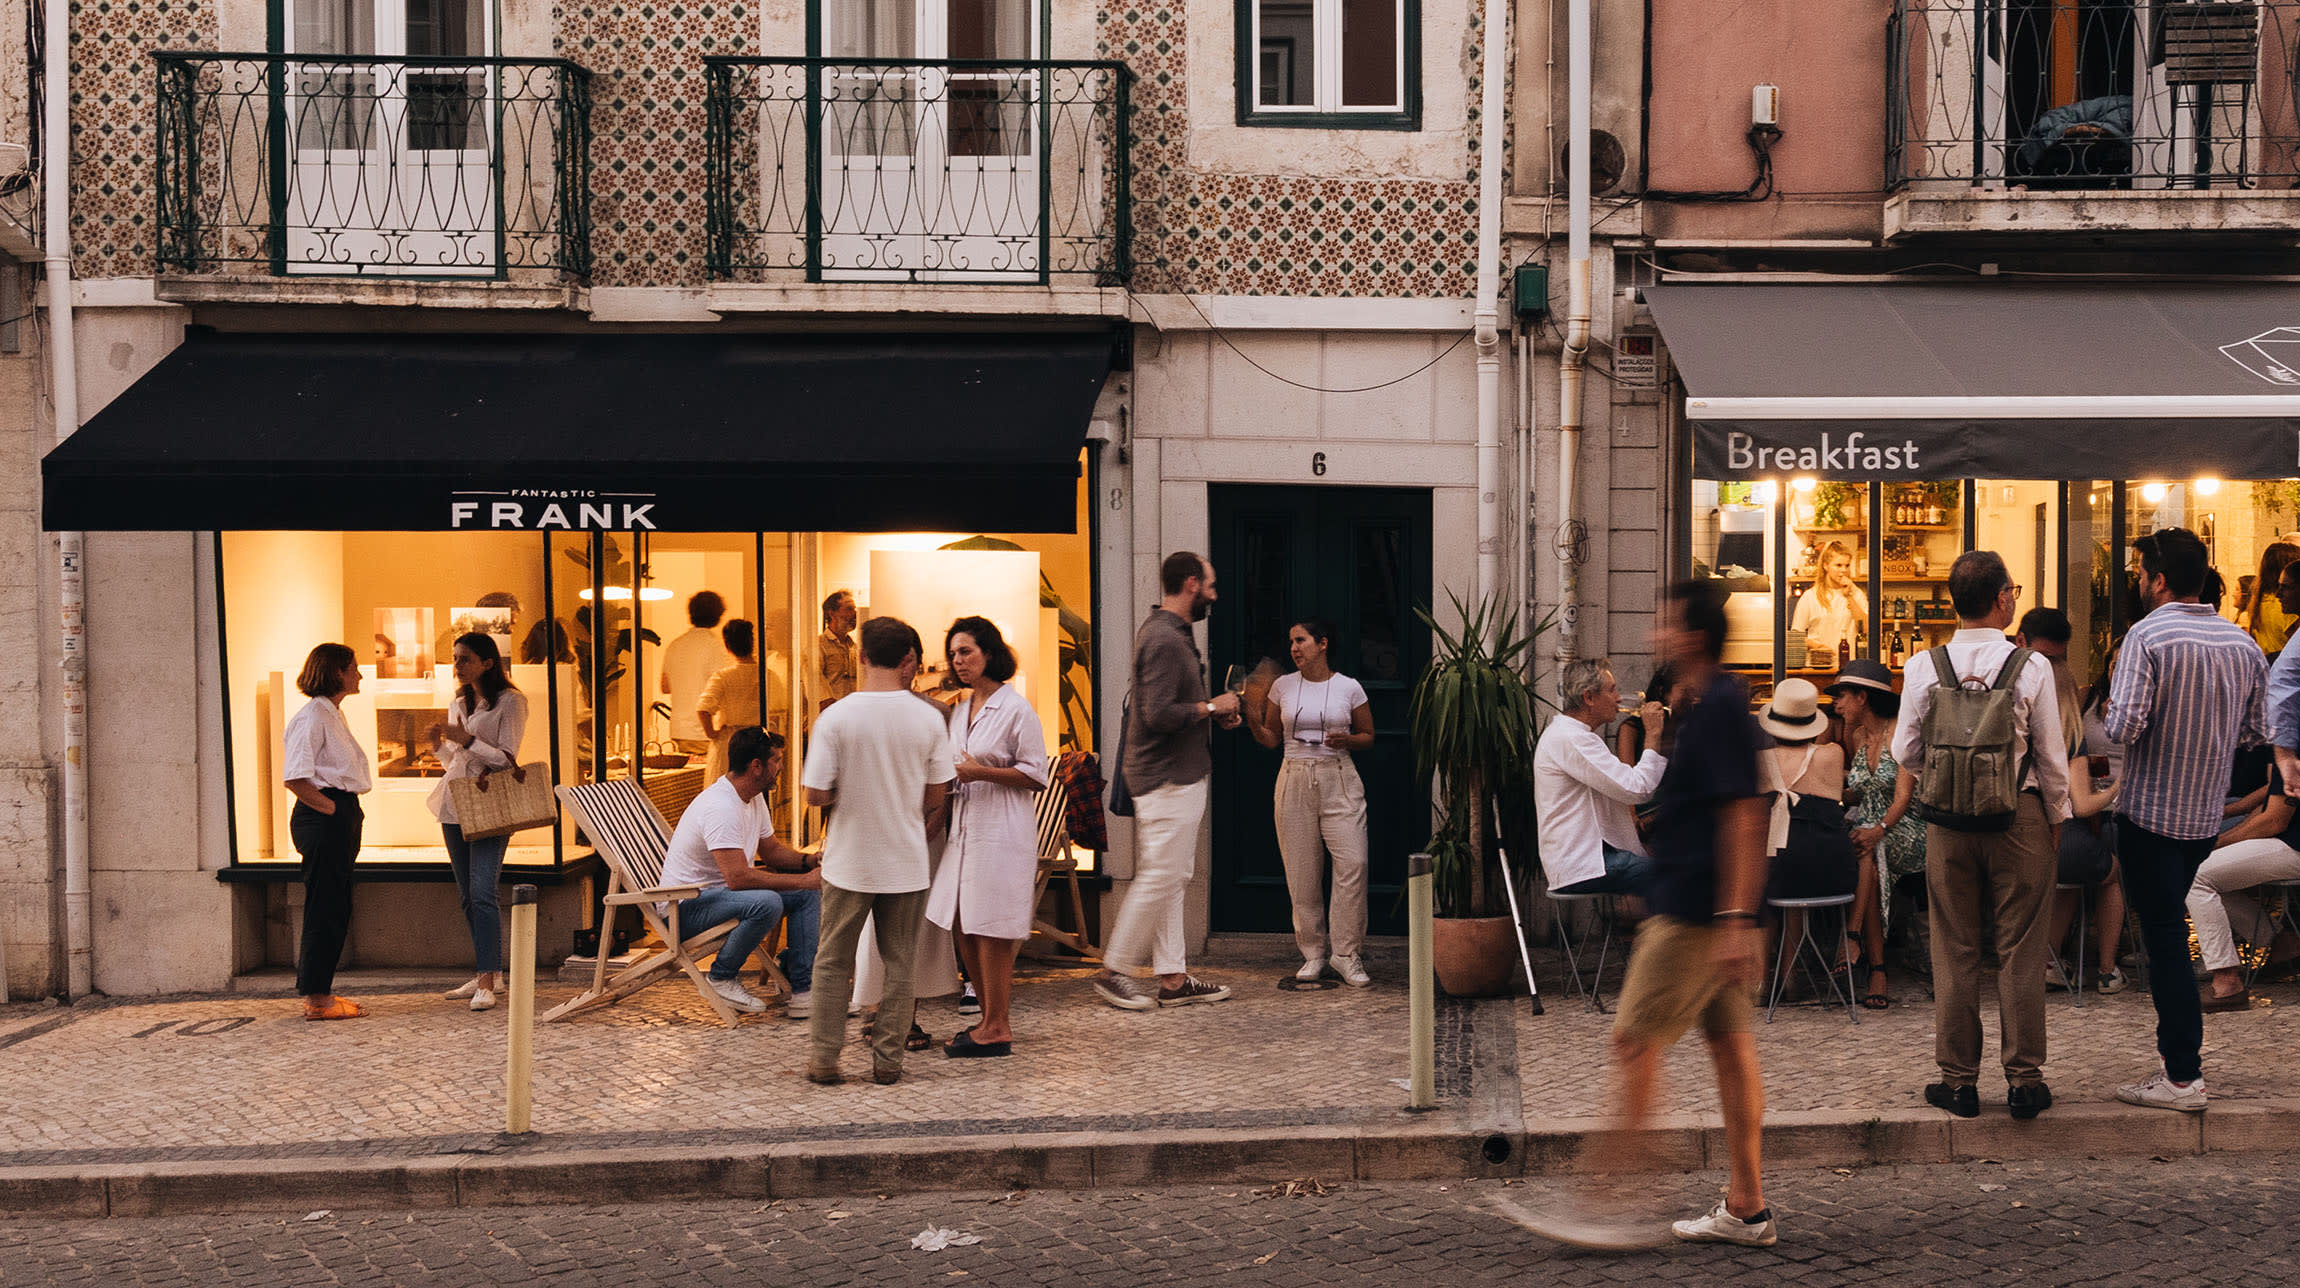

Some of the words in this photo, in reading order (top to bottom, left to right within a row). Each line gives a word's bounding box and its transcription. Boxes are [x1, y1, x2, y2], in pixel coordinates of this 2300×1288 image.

[1727, 432, 1920, 470] Breakfast
[1312, 452, 1326, 476] 6
[511, 489, 596, 498] FANTASTIC
[1110, 488, 1122, 511] 8
[451, 502, 657, 529] FRANK
[130, 1016, 256, 1039] 10
